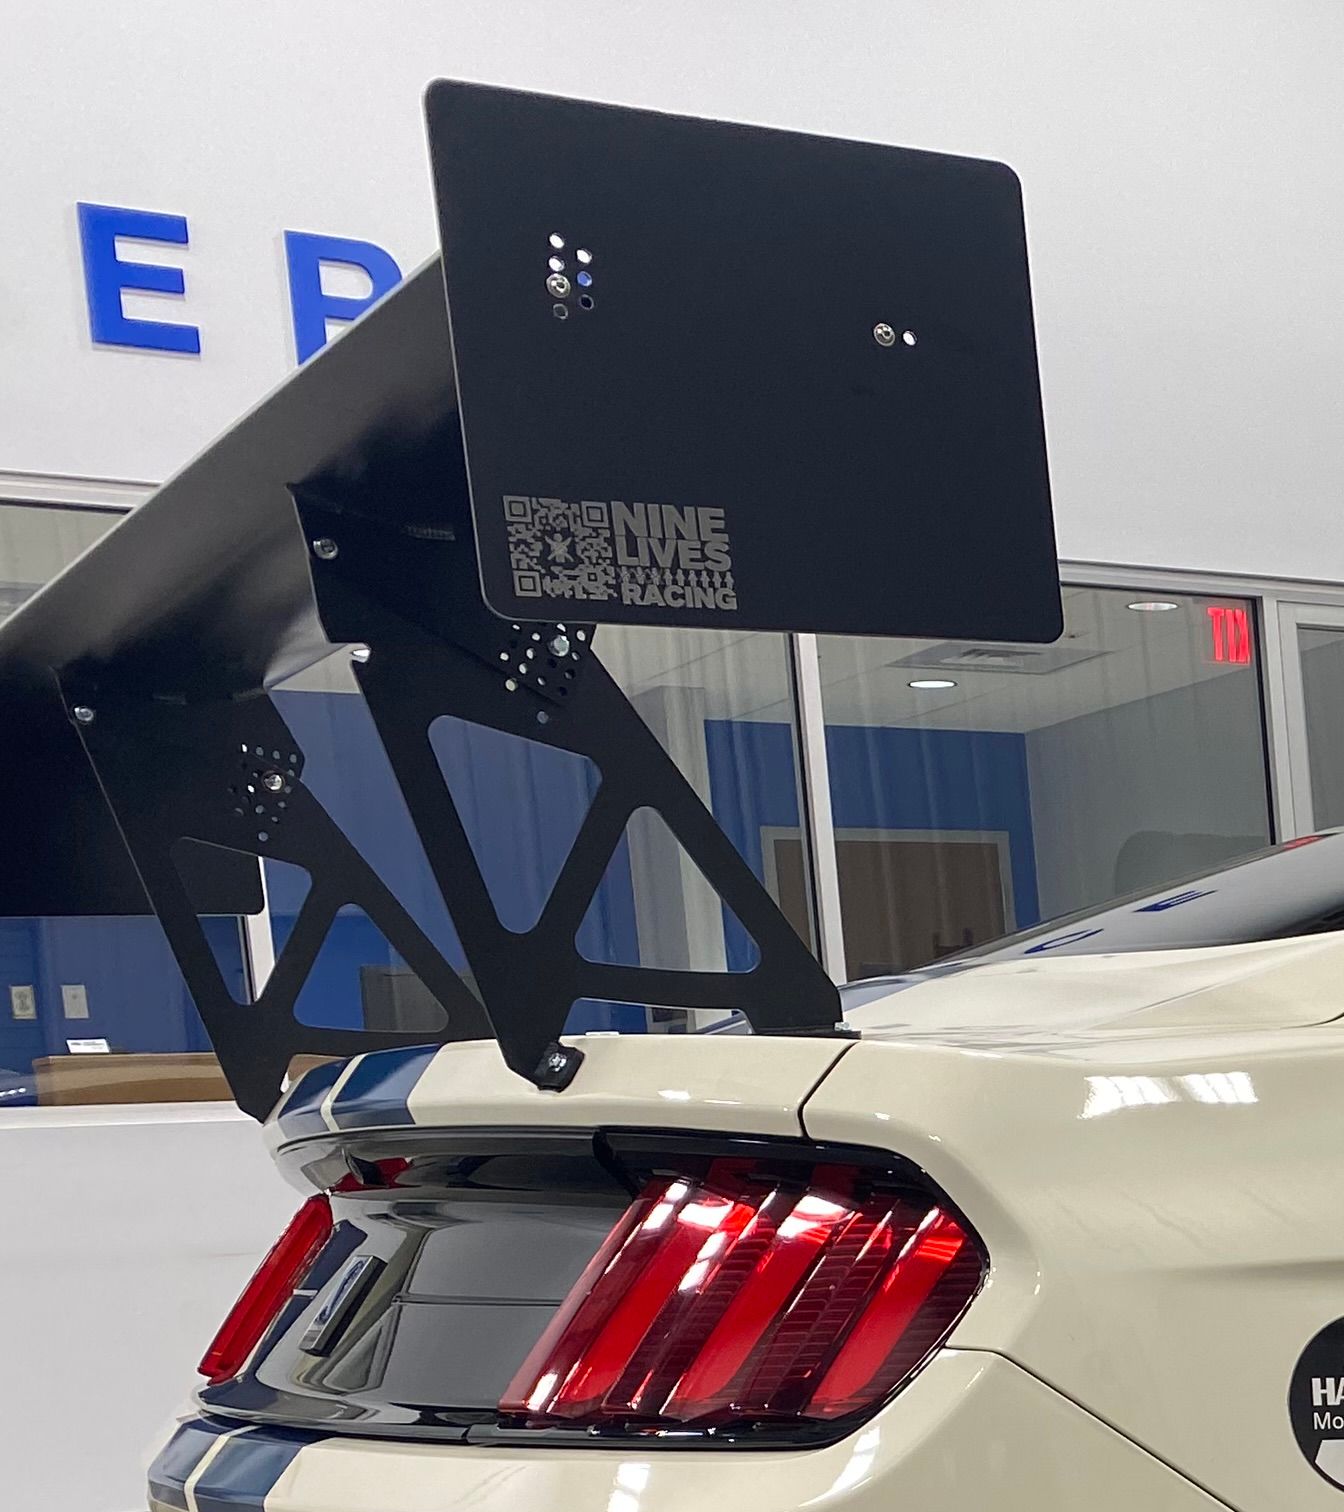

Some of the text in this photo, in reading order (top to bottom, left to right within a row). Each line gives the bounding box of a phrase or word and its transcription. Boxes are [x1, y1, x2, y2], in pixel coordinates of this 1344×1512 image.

[610, 500, 729, 544] NINE
[615, 536, 732, 571] LIVES
[621, 583, 738, 610] RACING
